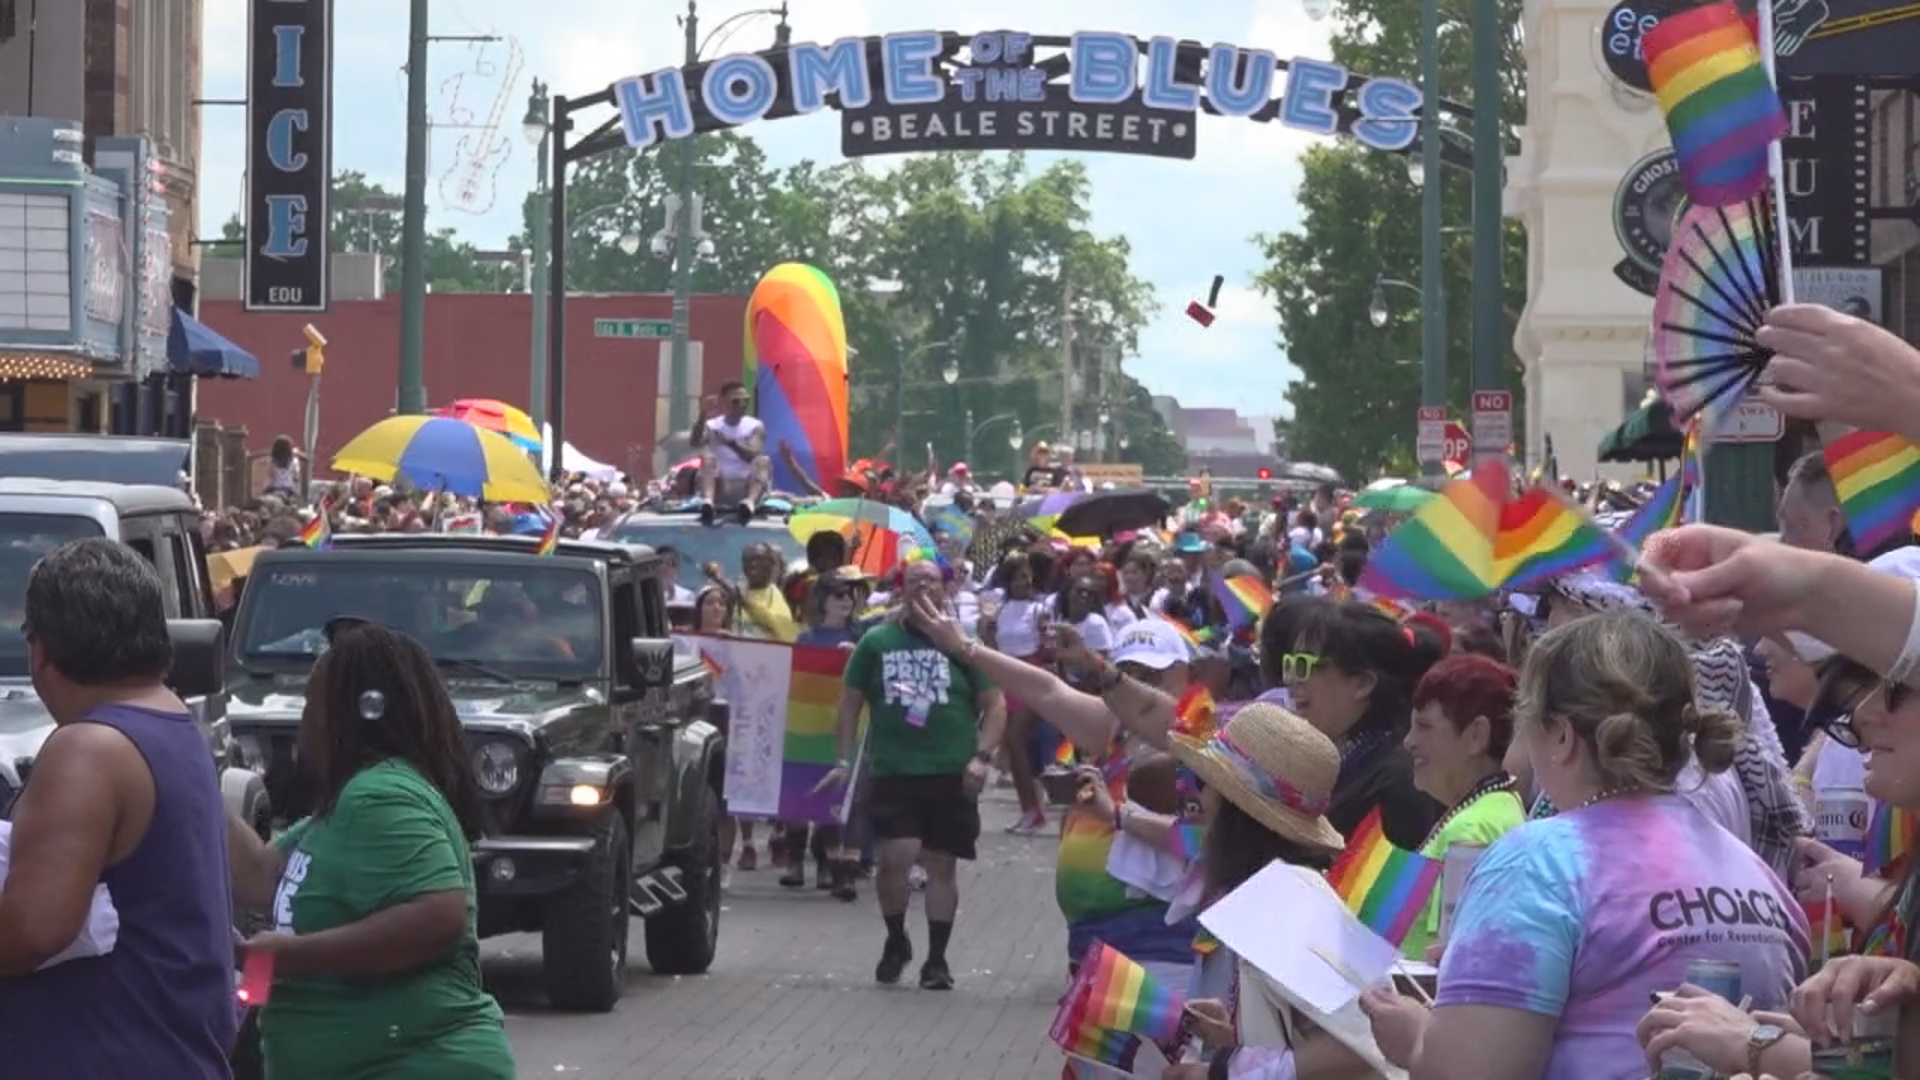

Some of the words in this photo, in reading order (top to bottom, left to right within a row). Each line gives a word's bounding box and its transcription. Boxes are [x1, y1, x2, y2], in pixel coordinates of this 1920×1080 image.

[970, 30, 1032, 64] OF
[614, 30, 944, 148] HOME
[957, 68, 1047, 102] THE
[1068, 30, 1424, 150] BLUES
[261, 1, 309, 261] ICE
[872, 111, 998, 142] BEALE
[1016, 111, 1167, 144] STREET
[1786, 76, 1823, 255] EUM
[268, 286, 303, 303] EDU
[1422, 409, 1441, 418] NO
[1480, 395, 1504, 409] NO
[1443, 439, 1468, 460] OP
[1658, 933, 1701, 948] Center
[1706, 931, 1724, 944] for
